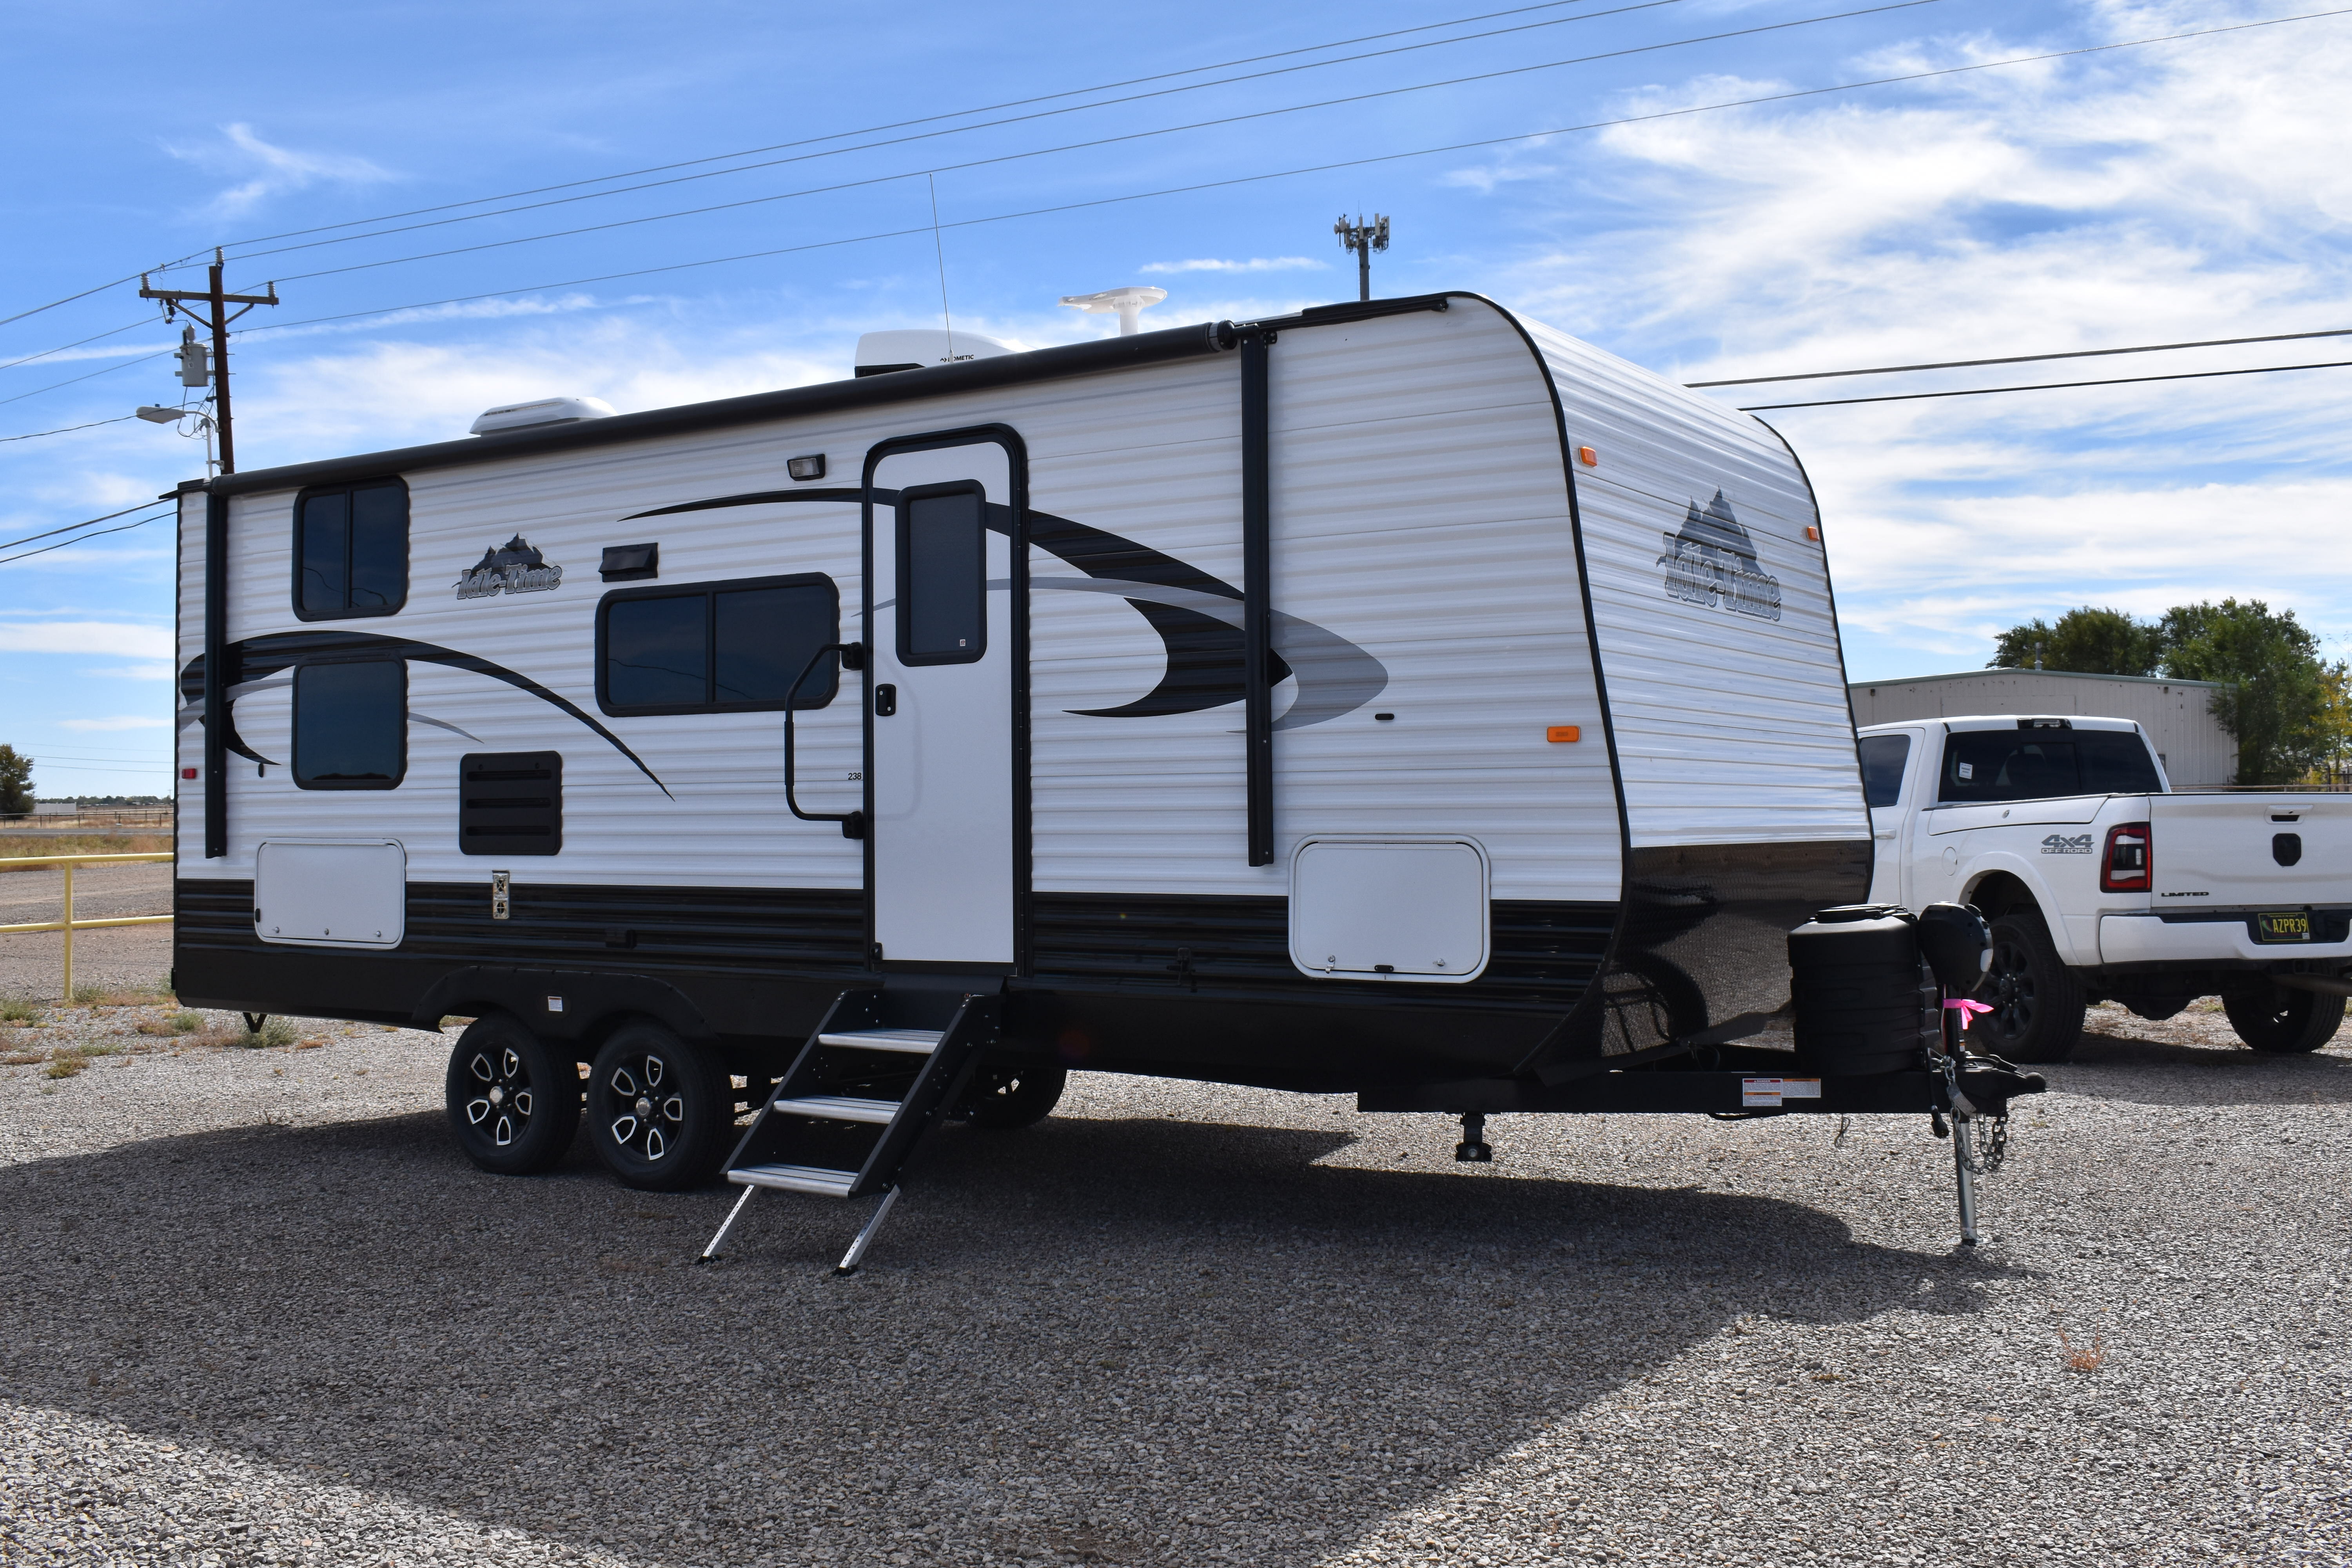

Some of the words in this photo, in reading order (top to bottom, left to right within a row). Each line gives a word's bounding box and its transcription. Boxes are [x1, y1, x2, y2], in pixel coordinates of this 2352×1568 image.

[457, 563, 563, 600] Idle-Time
[1663, 532, 1782, 622] Idle-Time
[2042, 834, 2094, 848] 4x4
[2272, 918, 2307, 933] AZPR39
